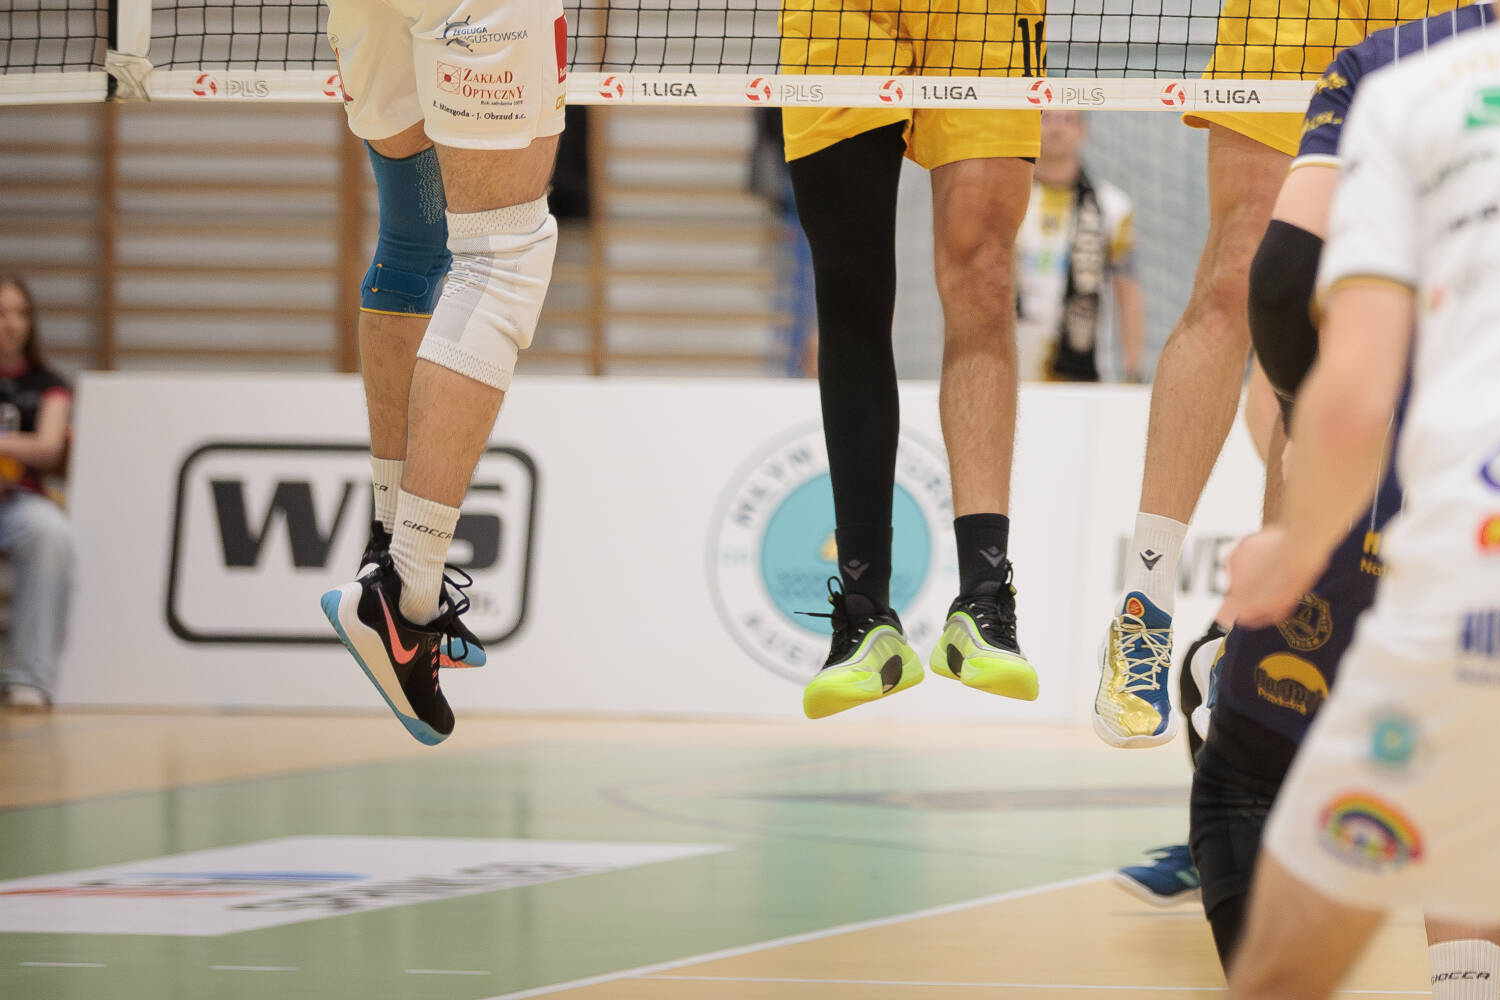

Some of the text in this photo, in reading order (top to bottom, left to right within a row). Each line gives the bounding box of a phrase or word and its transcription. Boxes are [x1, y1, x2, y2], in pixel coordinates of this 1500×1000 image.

[463, 67, 514, 84] ZAKŁAD
[225, 80, 269, 98] PLS
[462, 84, 526, 101] OPTYCZNY
[780, 84, 824, 103] PLS
[1061, 87, 1106, 106] PLS
